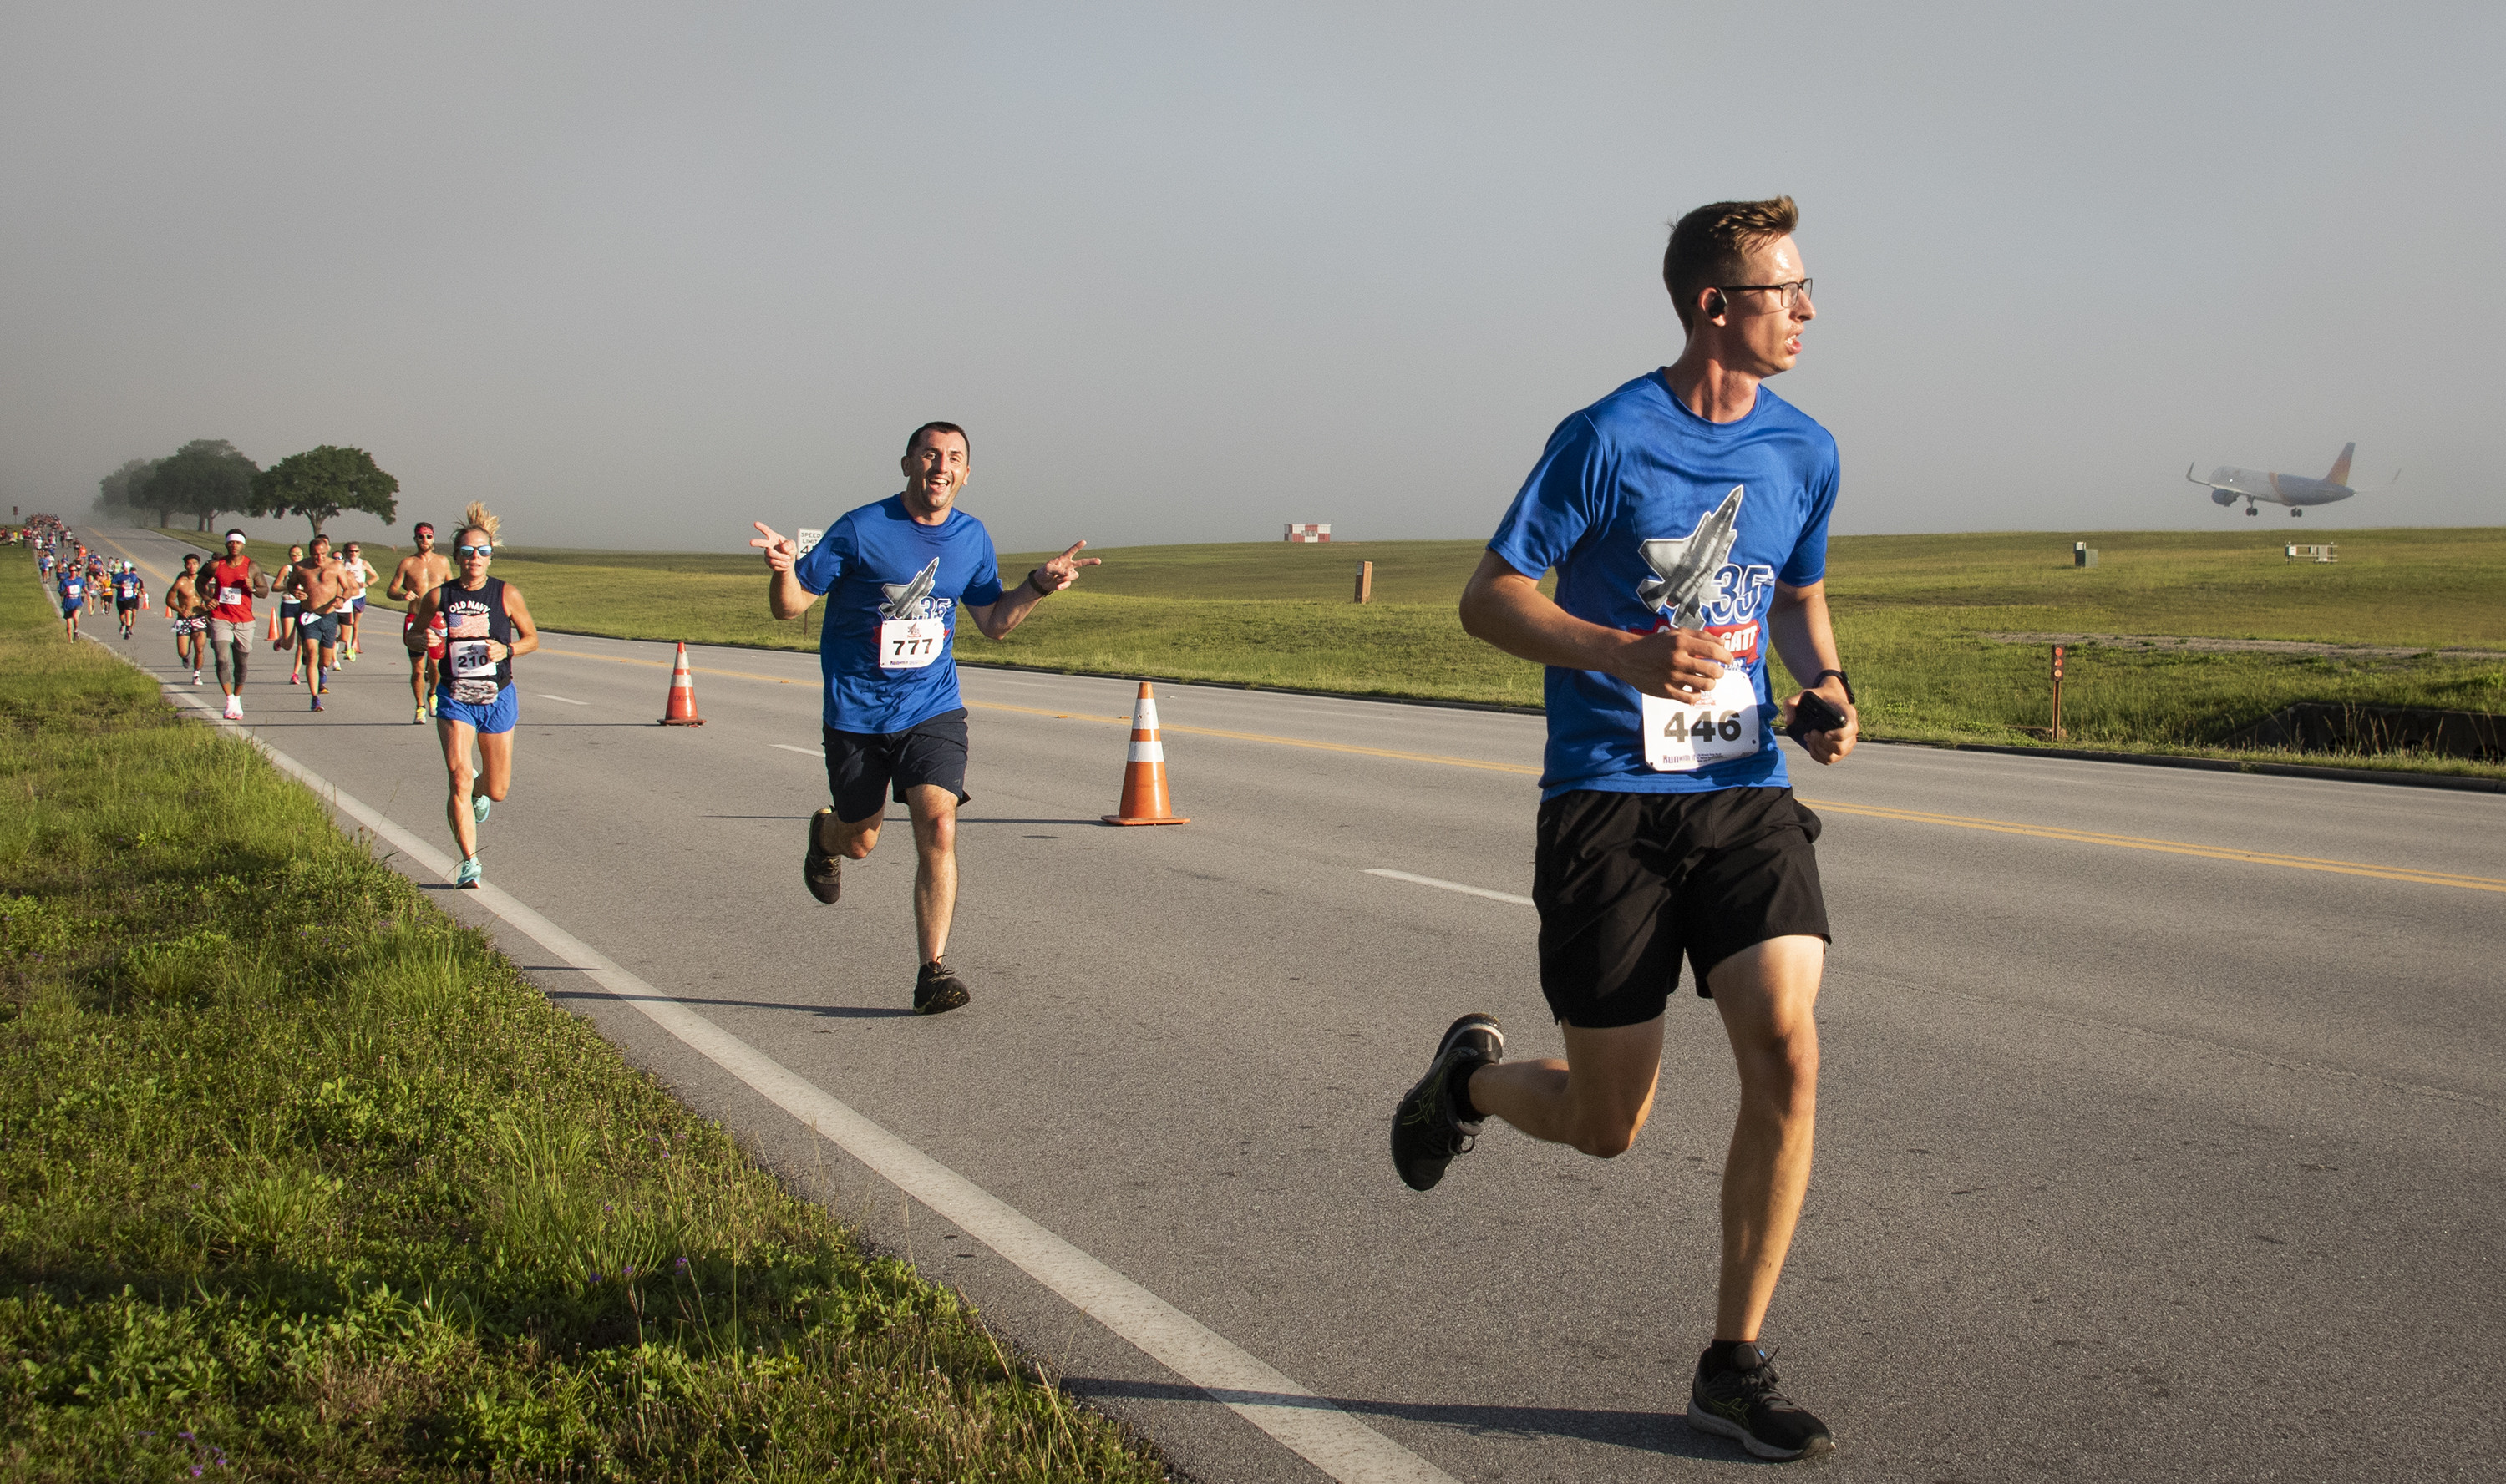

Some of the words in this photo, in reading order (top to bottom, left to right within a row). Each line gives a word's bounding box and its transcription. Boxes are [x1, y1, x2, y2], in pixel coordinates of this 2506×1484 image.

[449, 600, 467, 614] OLD
[467, 600, 491, 615] NAVY
[893, 638, 933, 656] 777
[458, 655, 489, 668] 210
[1663, 709, 1742, 742] 446
